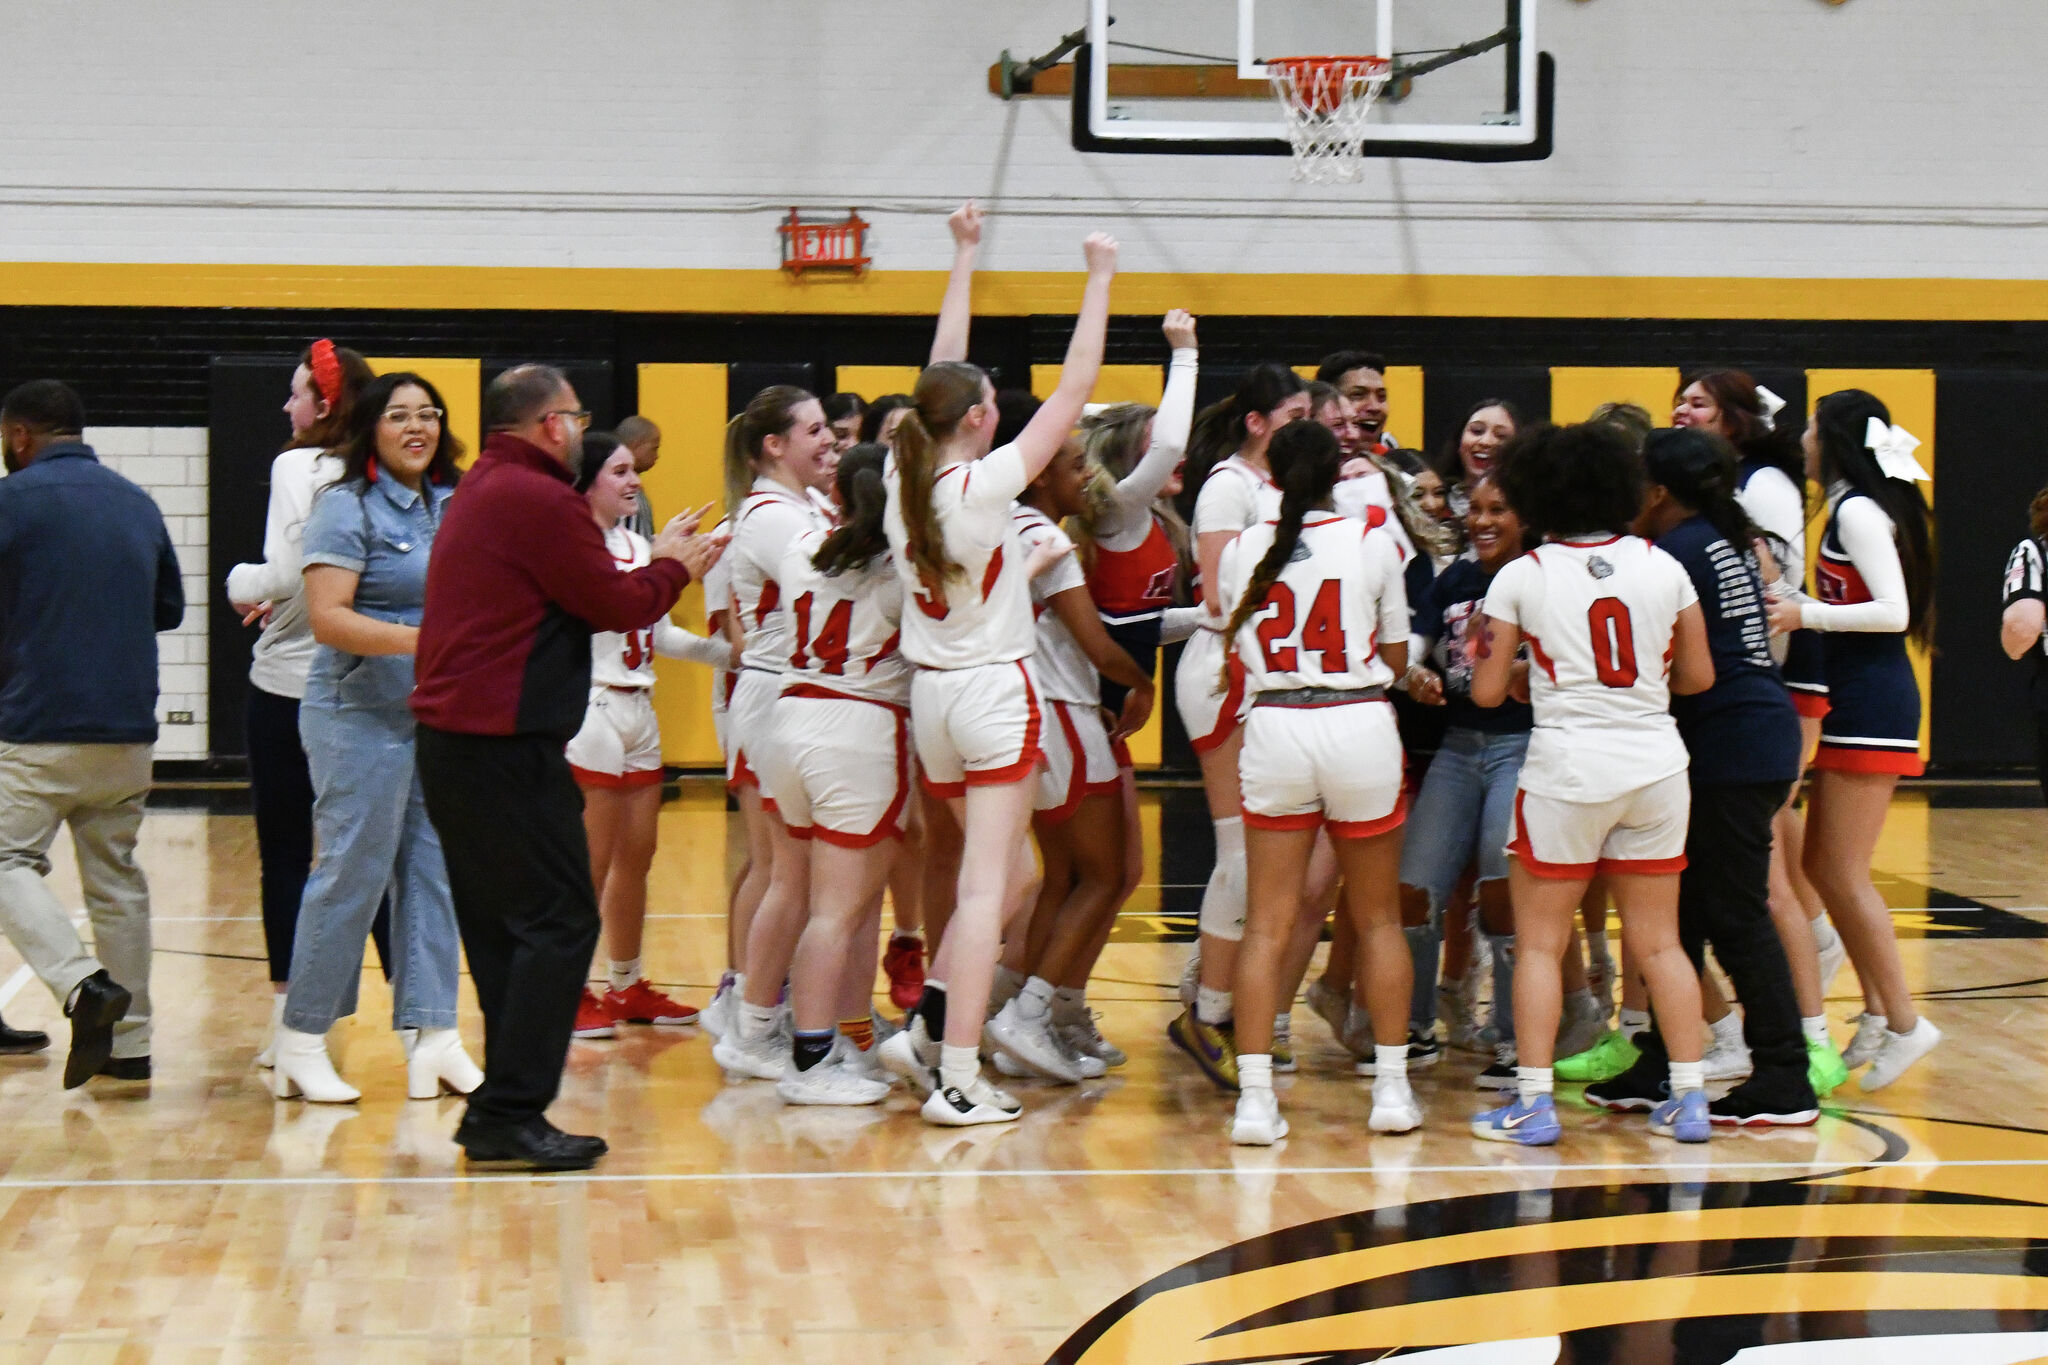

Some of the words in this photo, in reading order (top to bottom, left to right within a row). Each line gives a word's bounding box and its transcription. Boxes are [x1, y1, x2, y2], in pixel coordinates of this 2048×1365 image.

[789, 590, 854, 676] 14
[1254, 579, 1348, 674] 24
[1587, 596, 1638, 688] 0
